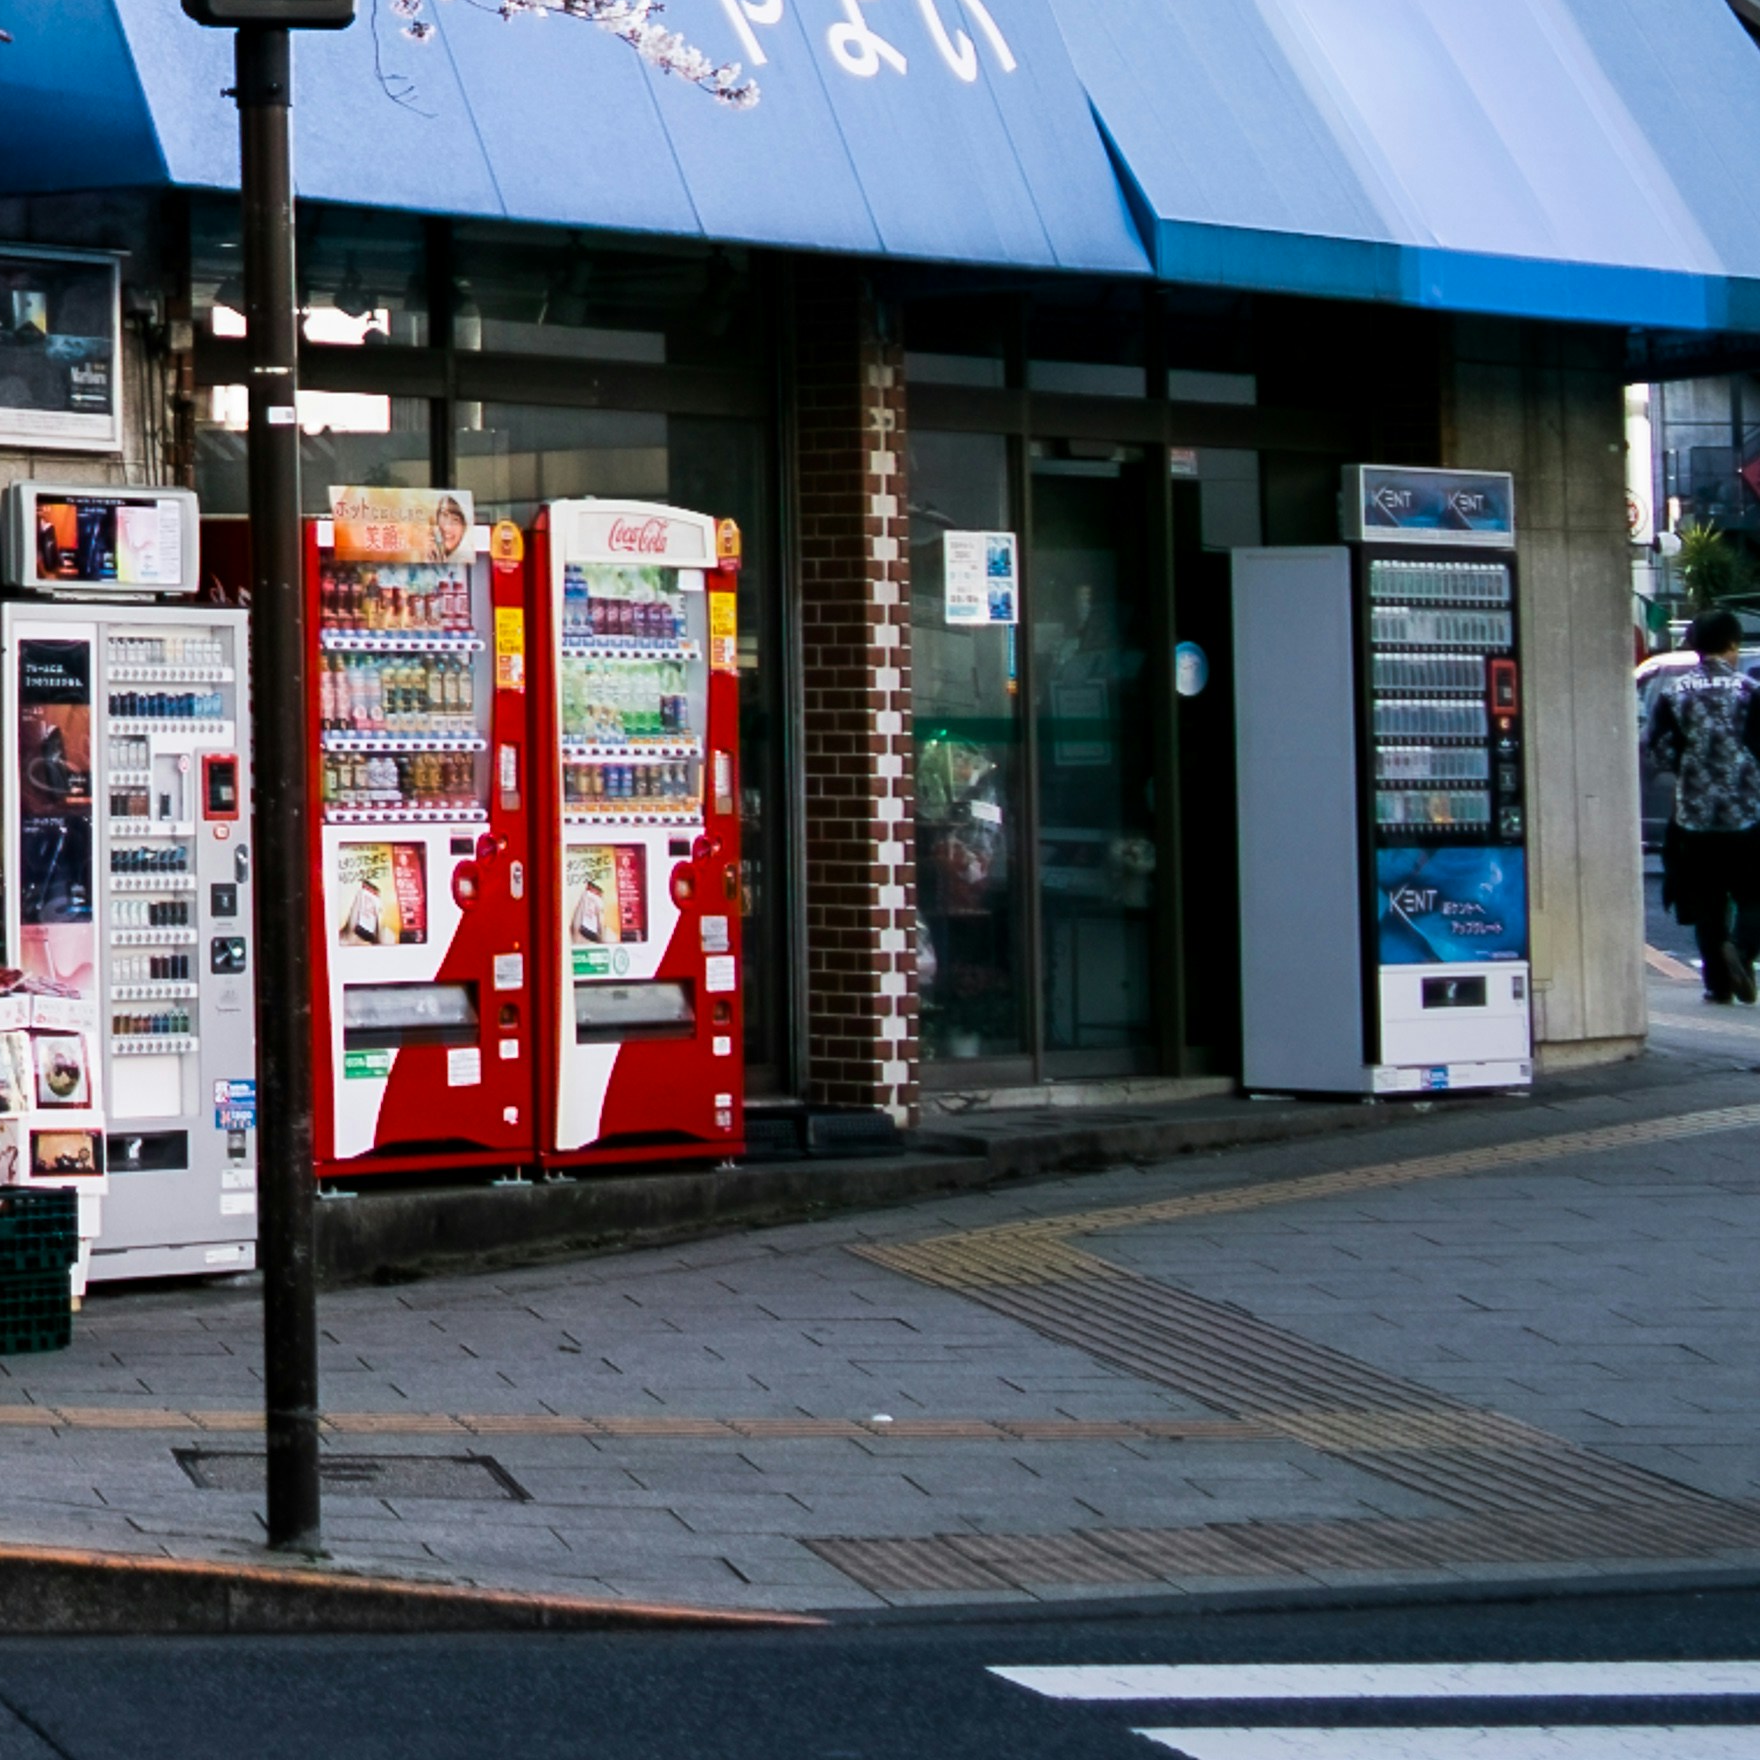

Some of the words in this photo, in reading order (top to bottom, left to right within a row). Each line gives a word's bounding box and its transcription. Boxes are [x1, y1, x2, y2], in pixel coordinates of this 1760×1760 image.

[1371, 486, 1413, 509] KENT
[1447, 490, 1485, 512] KENT
[1389, 884, 1438, 919] KENT
